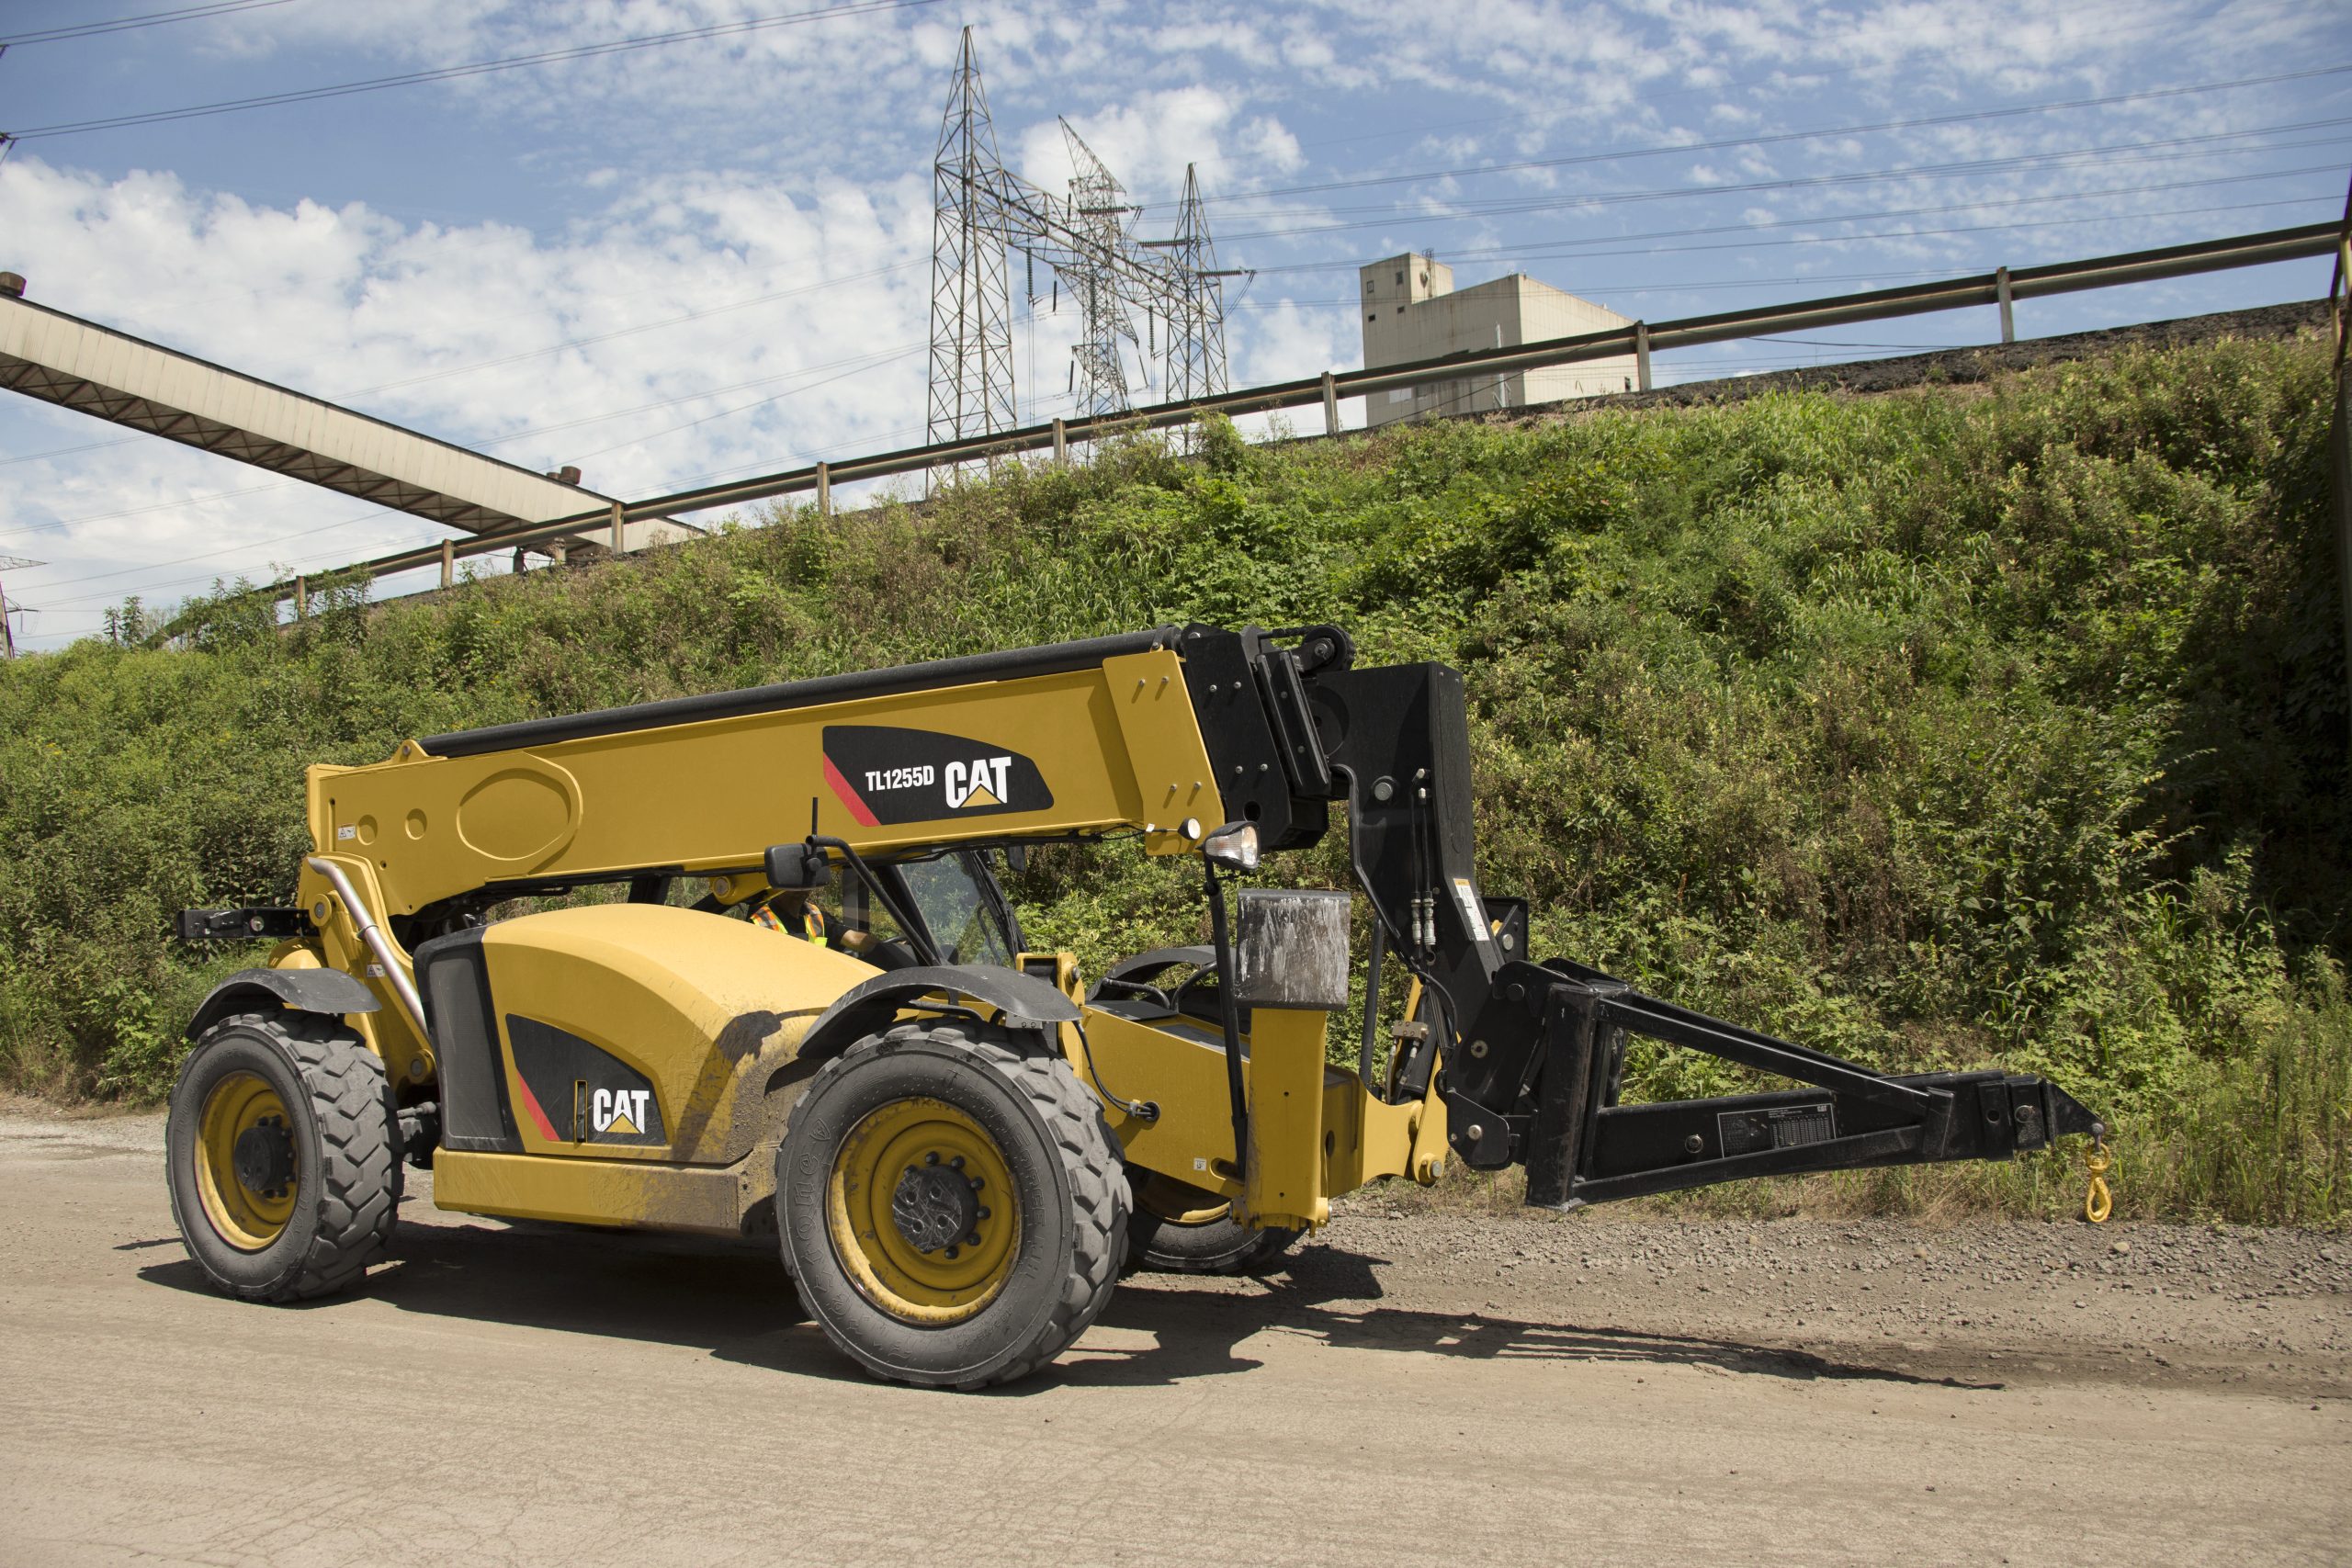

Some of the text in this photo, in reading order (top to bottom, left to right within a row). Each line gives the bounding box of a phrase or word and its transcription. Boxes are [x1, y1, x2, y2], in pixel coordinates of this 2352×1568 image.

[865, 756, 1012, 808] TL1255D CAT
[594, 1088, 650, 1134] CAT
